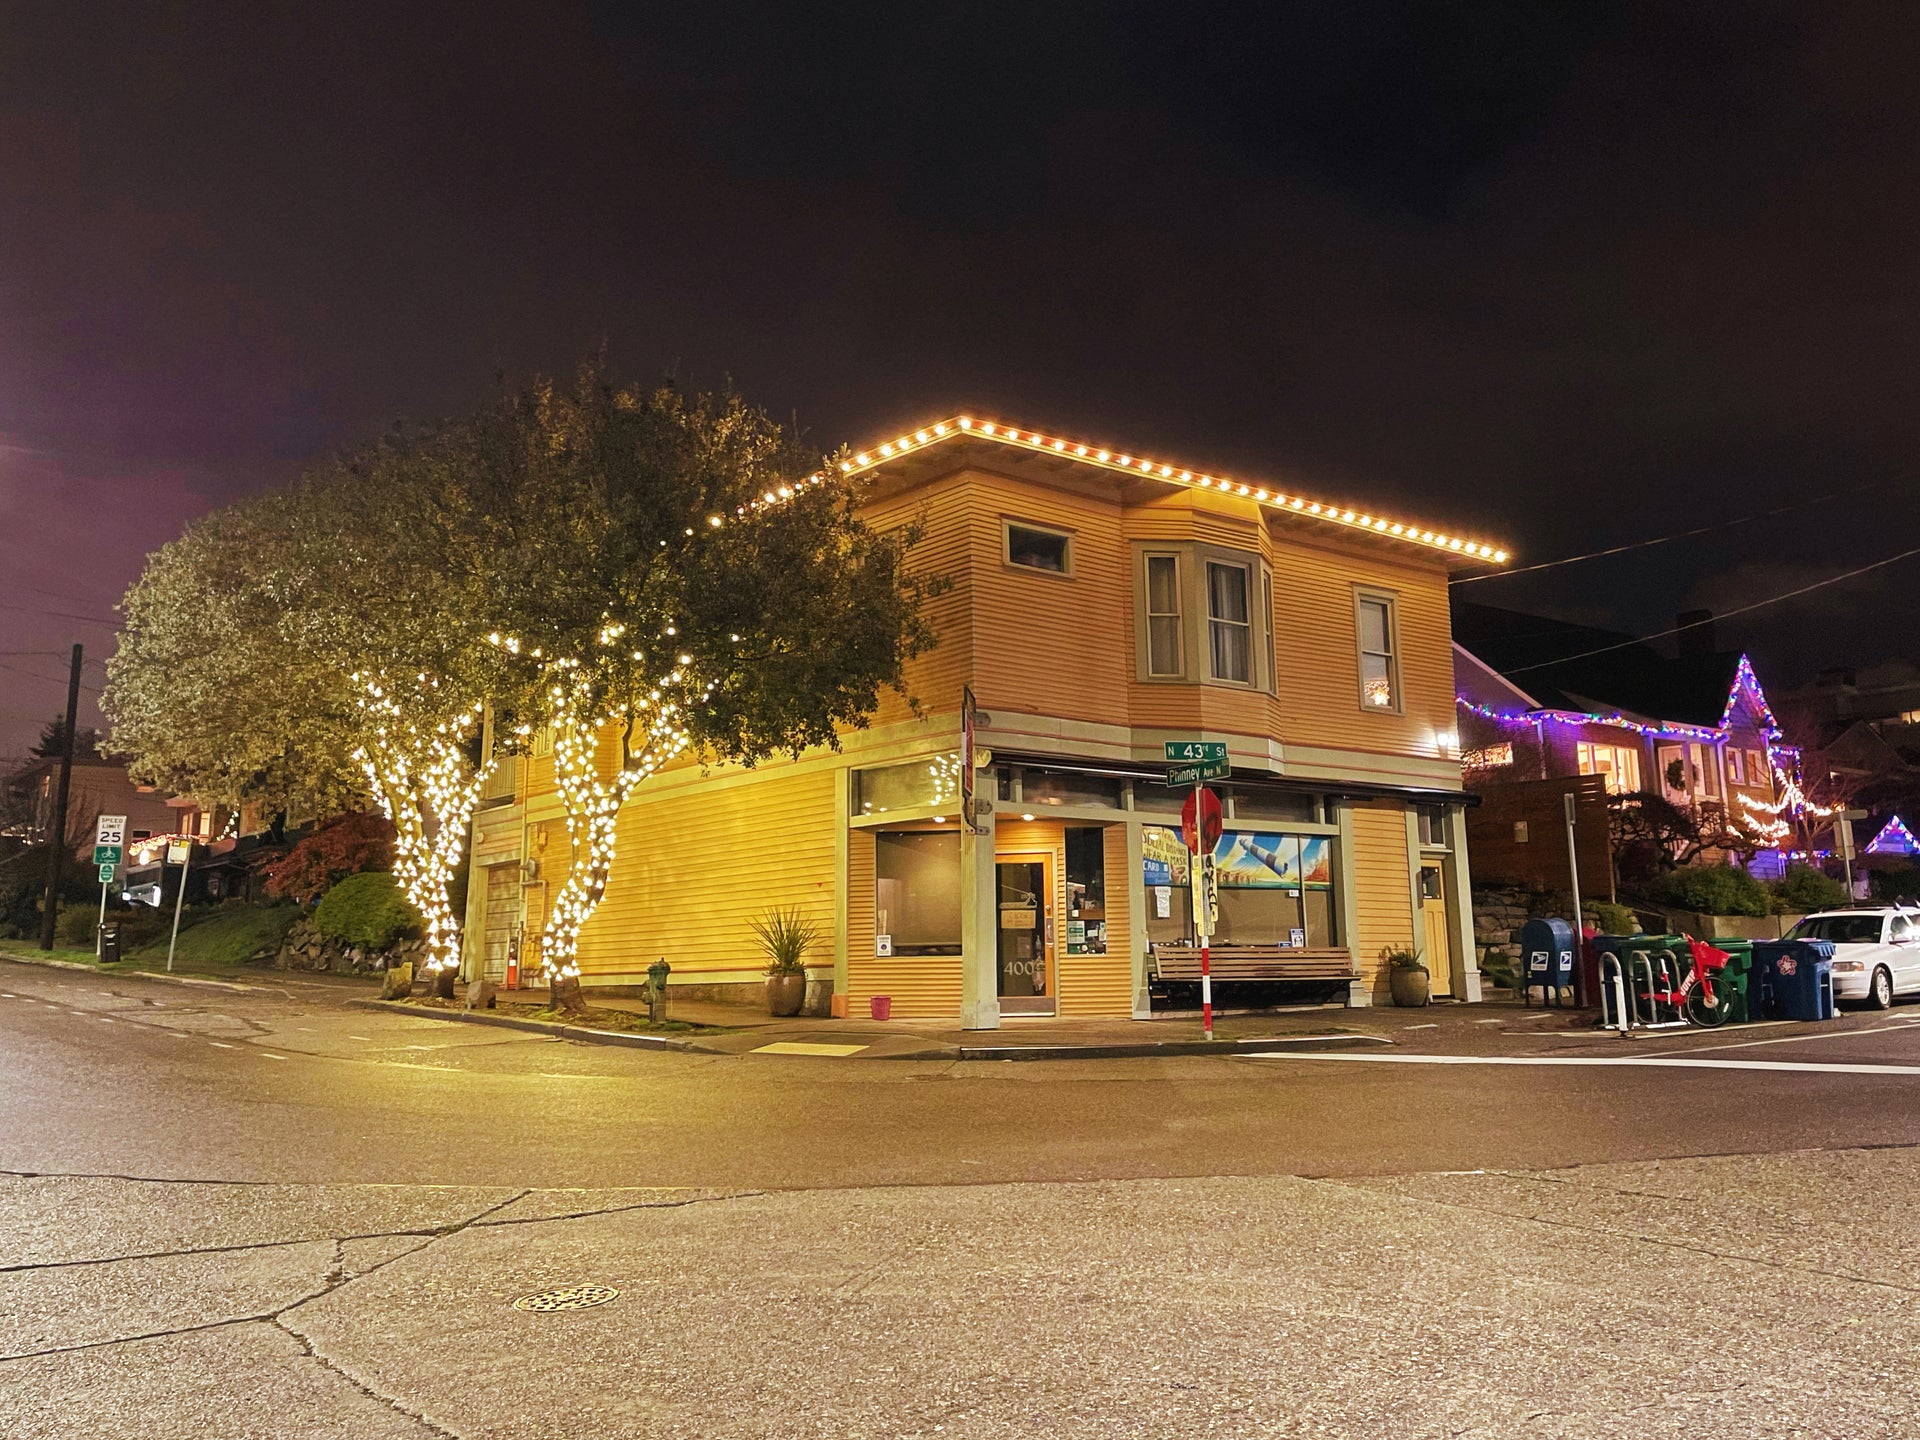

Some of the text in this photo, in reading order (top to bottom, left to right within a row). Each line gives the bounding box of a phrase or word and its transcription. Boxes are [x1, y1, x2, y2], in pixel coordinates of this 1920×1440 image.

[1168, 744, 1225, 759] N 43rd St
[1169, 765, 1222, 784] Phinney Ave N
[100, 831, 121, 843] 25
[1170, 855, 1187, 866] MASK
[1680, 969, 1696, 996] JUMP
